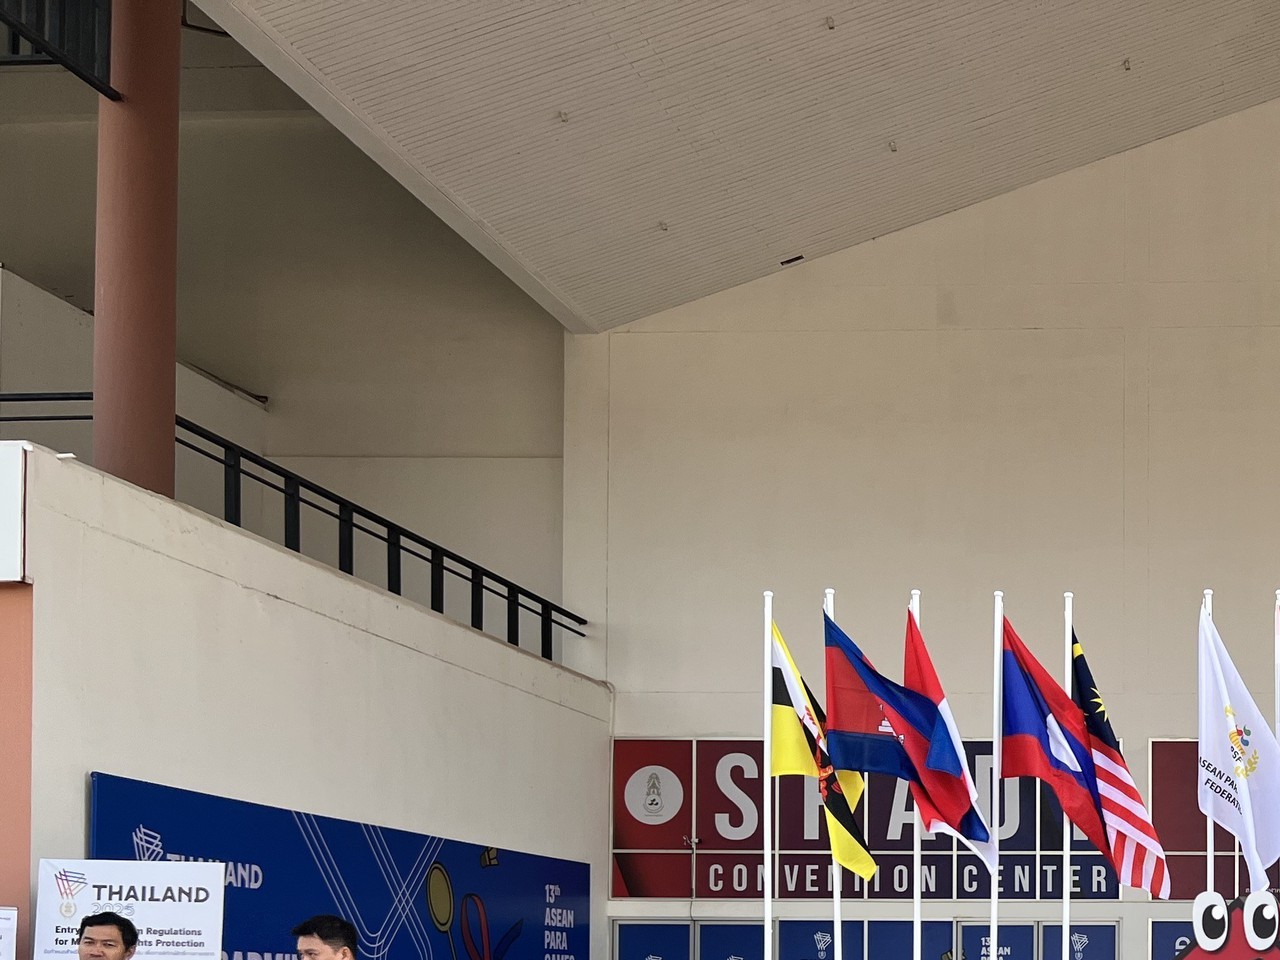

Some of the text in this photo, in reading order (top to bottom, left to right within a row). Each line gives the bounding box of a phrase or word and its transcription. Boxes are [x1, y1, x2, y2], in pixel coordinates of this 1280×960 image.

[92, 884, 210, 903] THAILAND
[545, 884, 560, 904] 13th
[544, 907, 574, 928] ASEAN
[147, 927, 202, 938] Regulations
[544, 930, 568, 950] PARA
[155, 938, 205, 948] Protection
[981, 947, 1011, 955] ASAN
